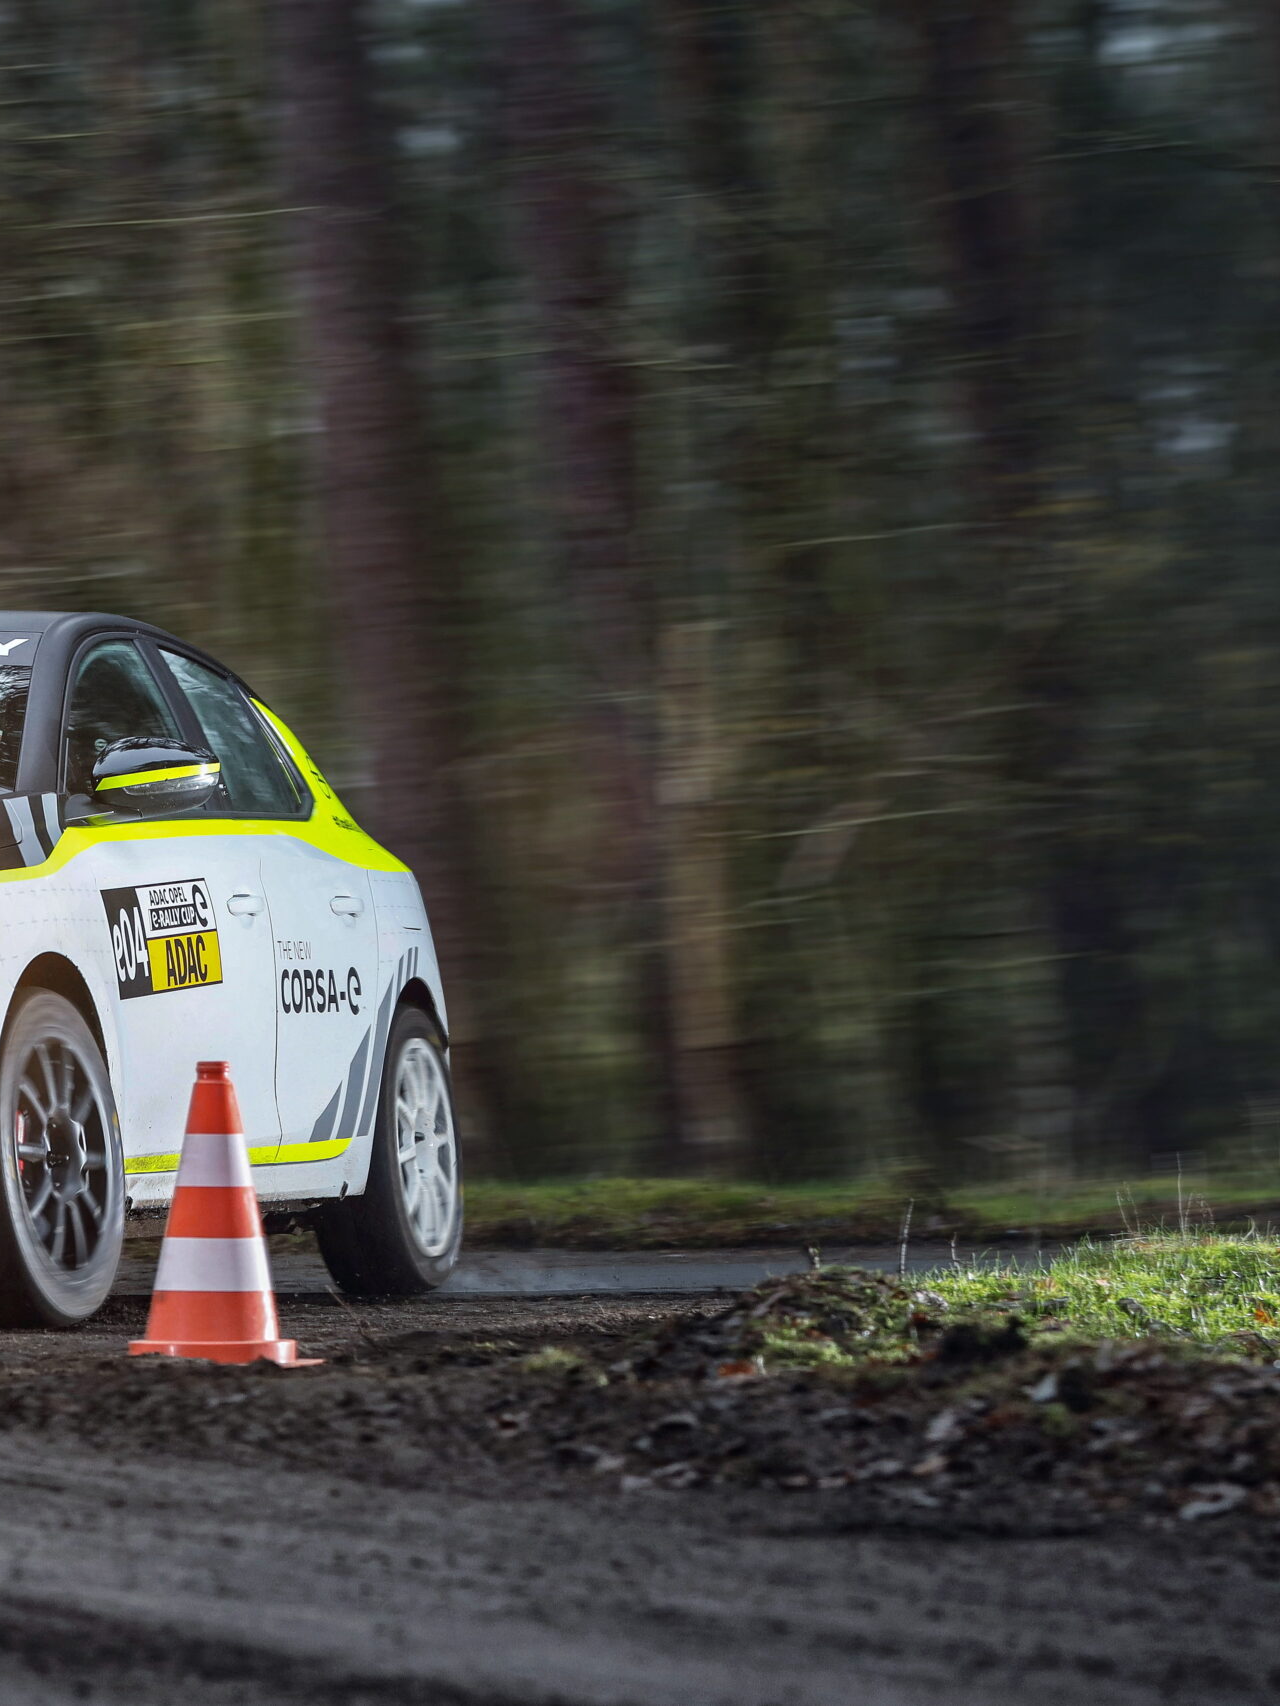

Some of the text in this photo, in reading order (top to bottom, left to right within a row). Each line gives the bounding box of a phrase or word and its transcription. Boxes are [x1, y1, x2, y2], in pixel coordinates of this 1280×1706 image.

[148, 886, 188, 907] ADAC OPEL
[180, 906, 196, 924] CUP
[277, 940, 311, 960] THE NEW
[165, 934, 208, 987] ADAC
